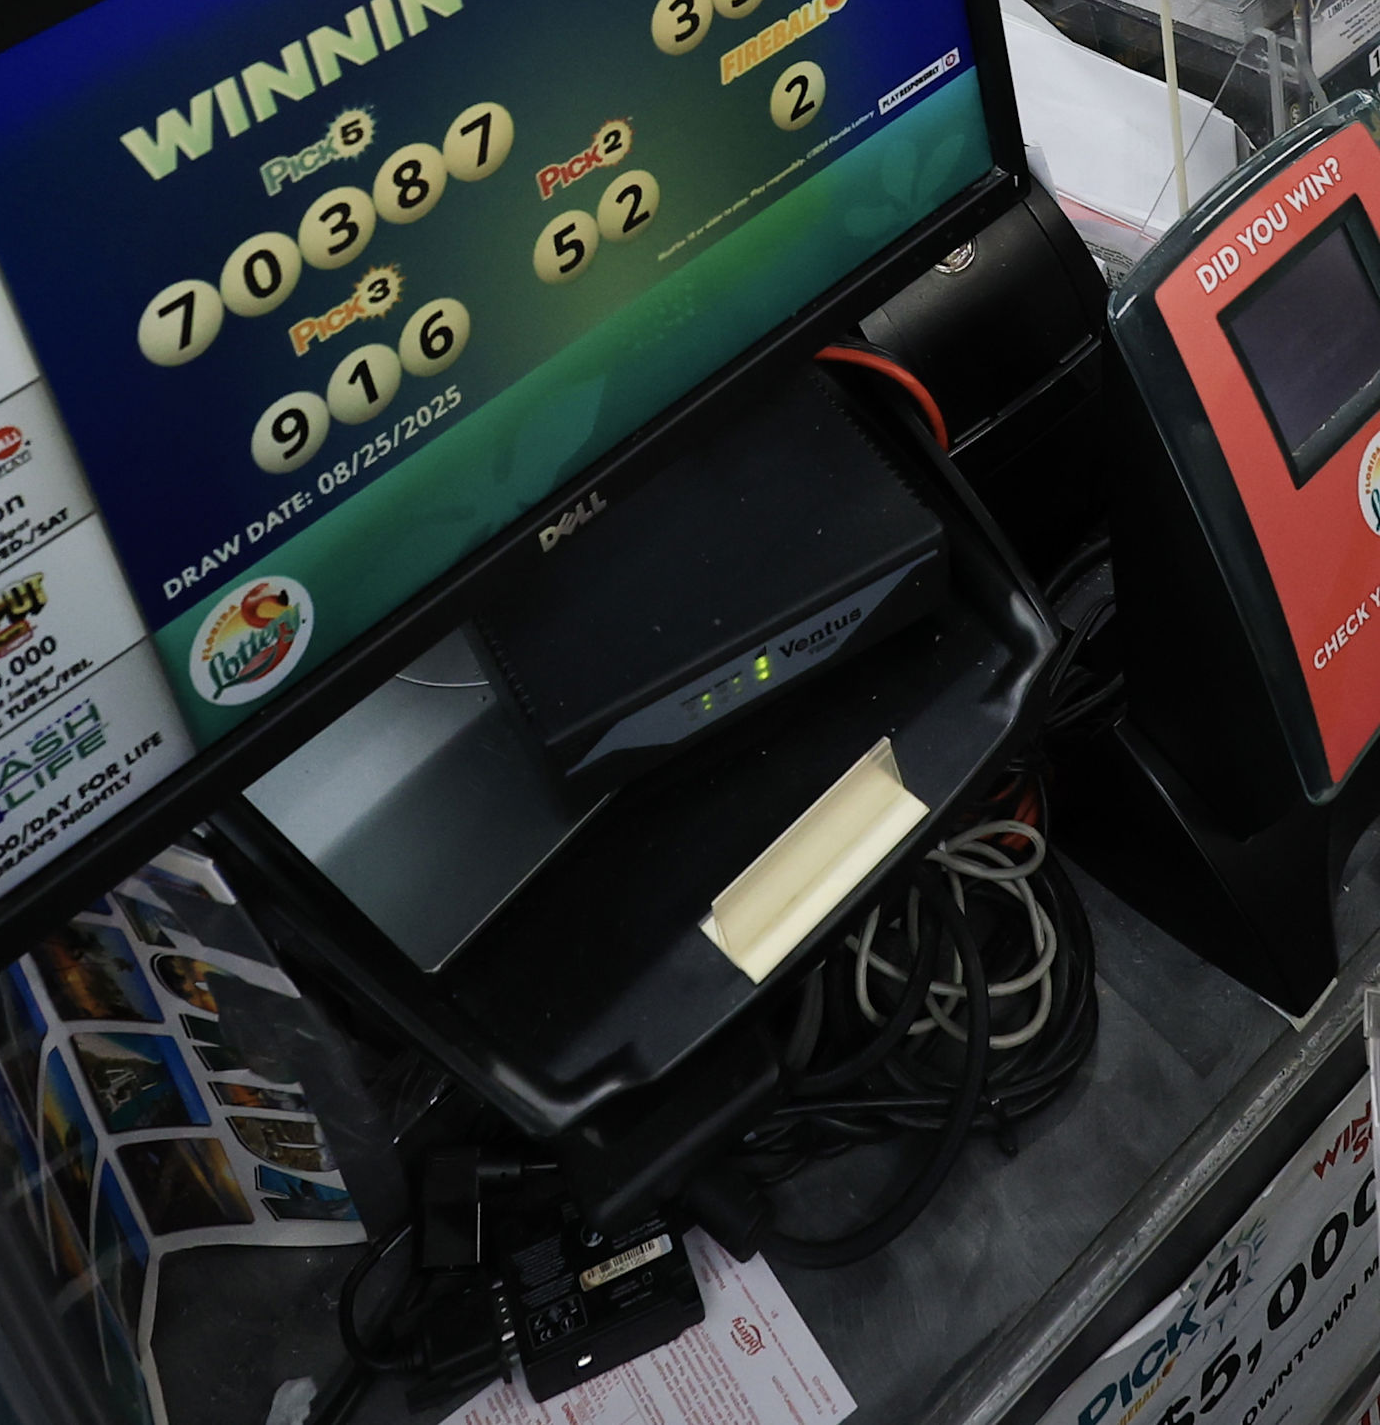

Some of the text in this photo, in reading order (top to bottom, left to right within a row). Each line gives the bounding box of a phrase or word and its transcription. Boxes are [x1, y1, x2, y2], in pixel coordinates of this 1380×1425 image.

[784, 74, 815, 122] 2
[158, 112, 493, 350] 7 0 3 8 7
[553, 223, 585, 275] 5
[616, 183, 650, 232] 2
[1195, 157, 1342, 295] DID YOU WIN?
[271, 310, 453, 460] 9 1 6
[162, 384, 463, 600] DRAW DATE: 08/25/2025
[538, 492, 607, 552] DELL
[209, 602, 303, 700] Lottery
[779, 606, 861, 661] Ventus
[1312, 605, 1372, 672] CHECK
[59, 773, 135, 831] NIGHTLY
[76, 763, 121, 802] FOR
[124, 733, 165, 768] LIFE
